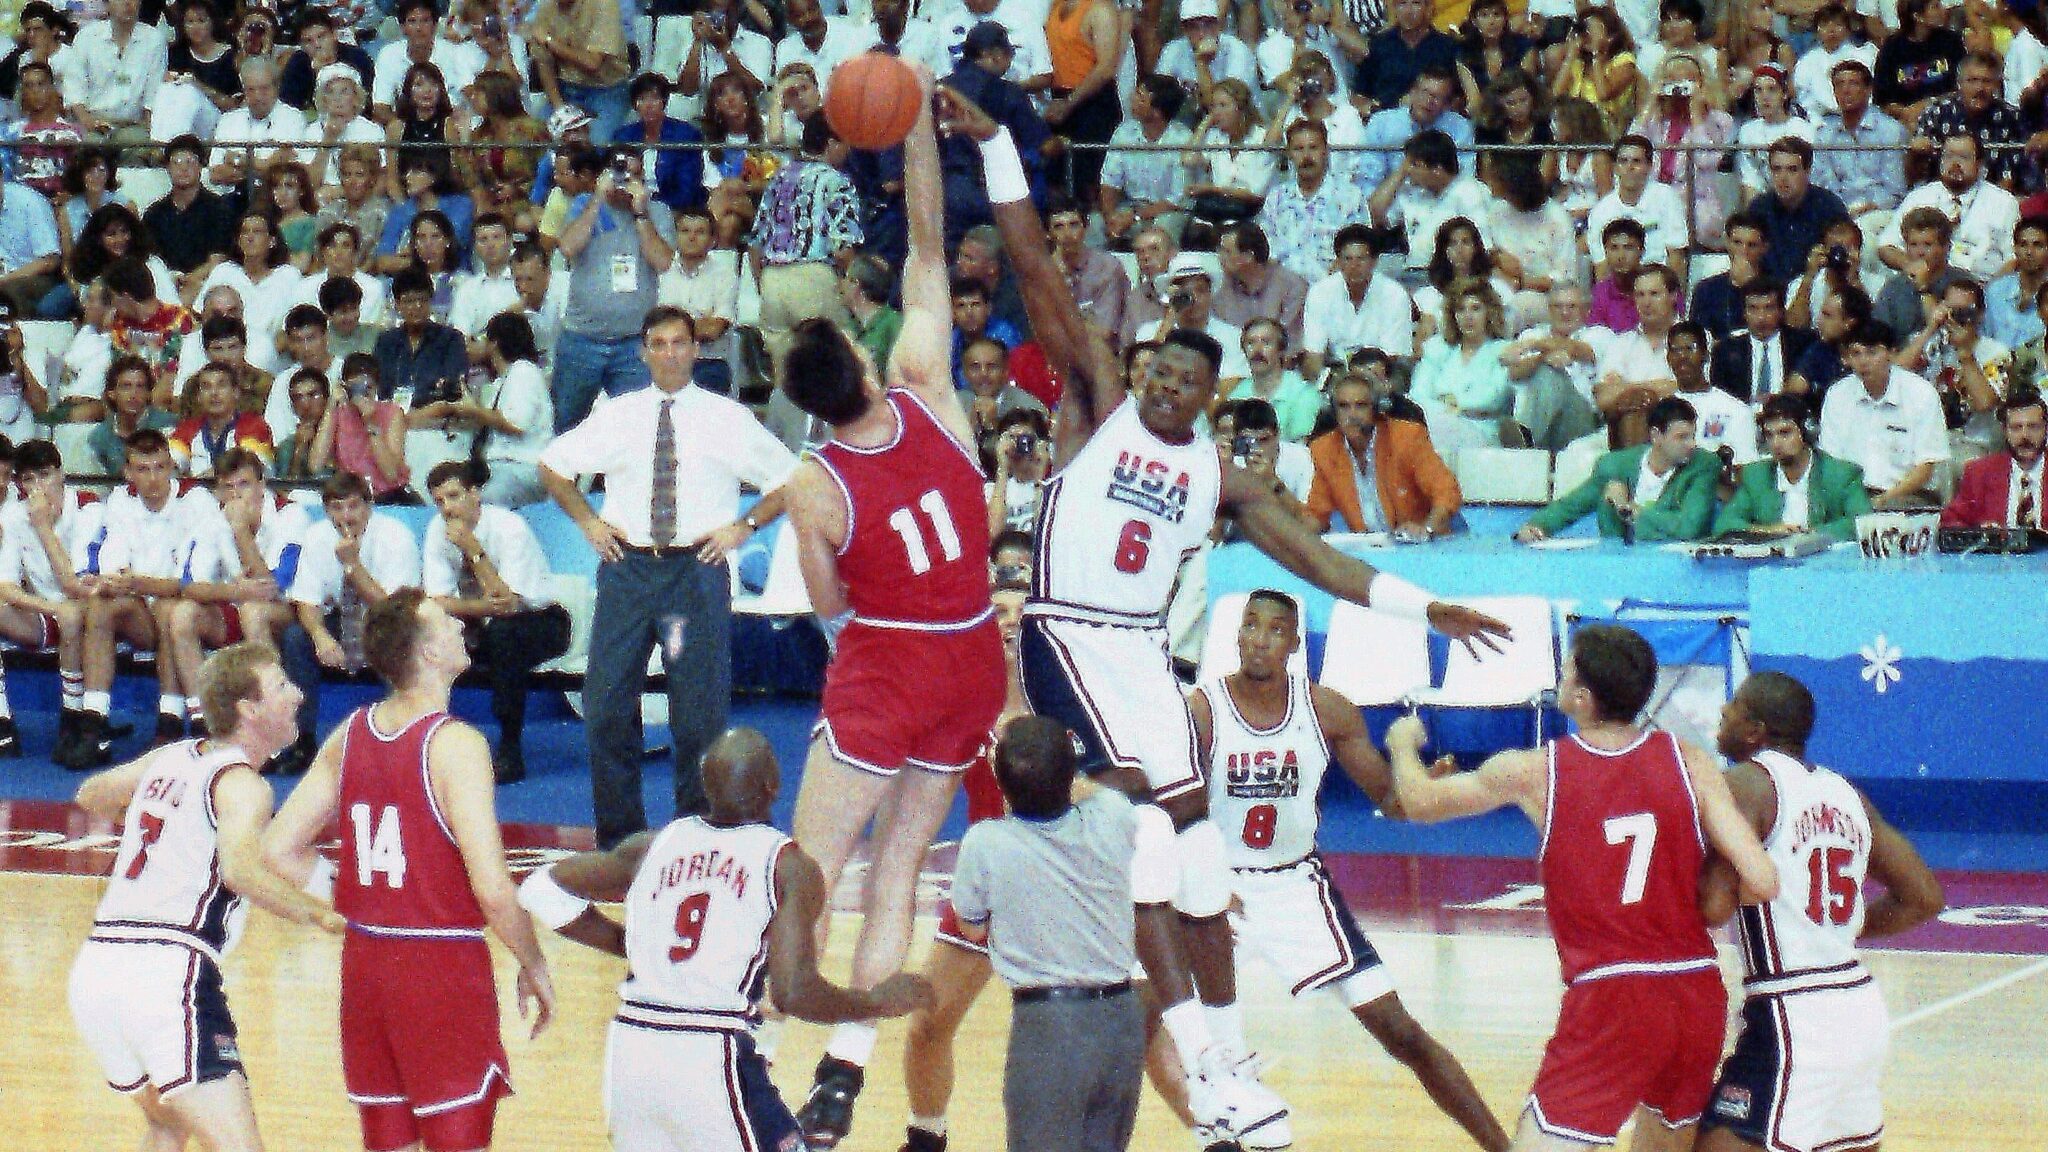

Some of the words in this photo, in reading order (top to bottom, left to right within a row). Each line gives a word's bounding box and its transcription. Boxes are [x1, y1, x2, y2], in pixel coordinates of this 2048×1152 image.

[1113, 450, 1190, 508] USA
[888, 488, 961, 576] 11
[1113, 519, 1152, 574] 6
[144, 777, 187, 808] BI
[1226, 750, 1299, 784] USA
[124, 809, 164, 880] 7
[351, 803, 407, 888] 14
[1241, 804, 1278, 850] 8
[1602, 813, 1657, 905] 7
[1804, 847, 1859, 926] 15
[668, 891, 712, 964] 9
